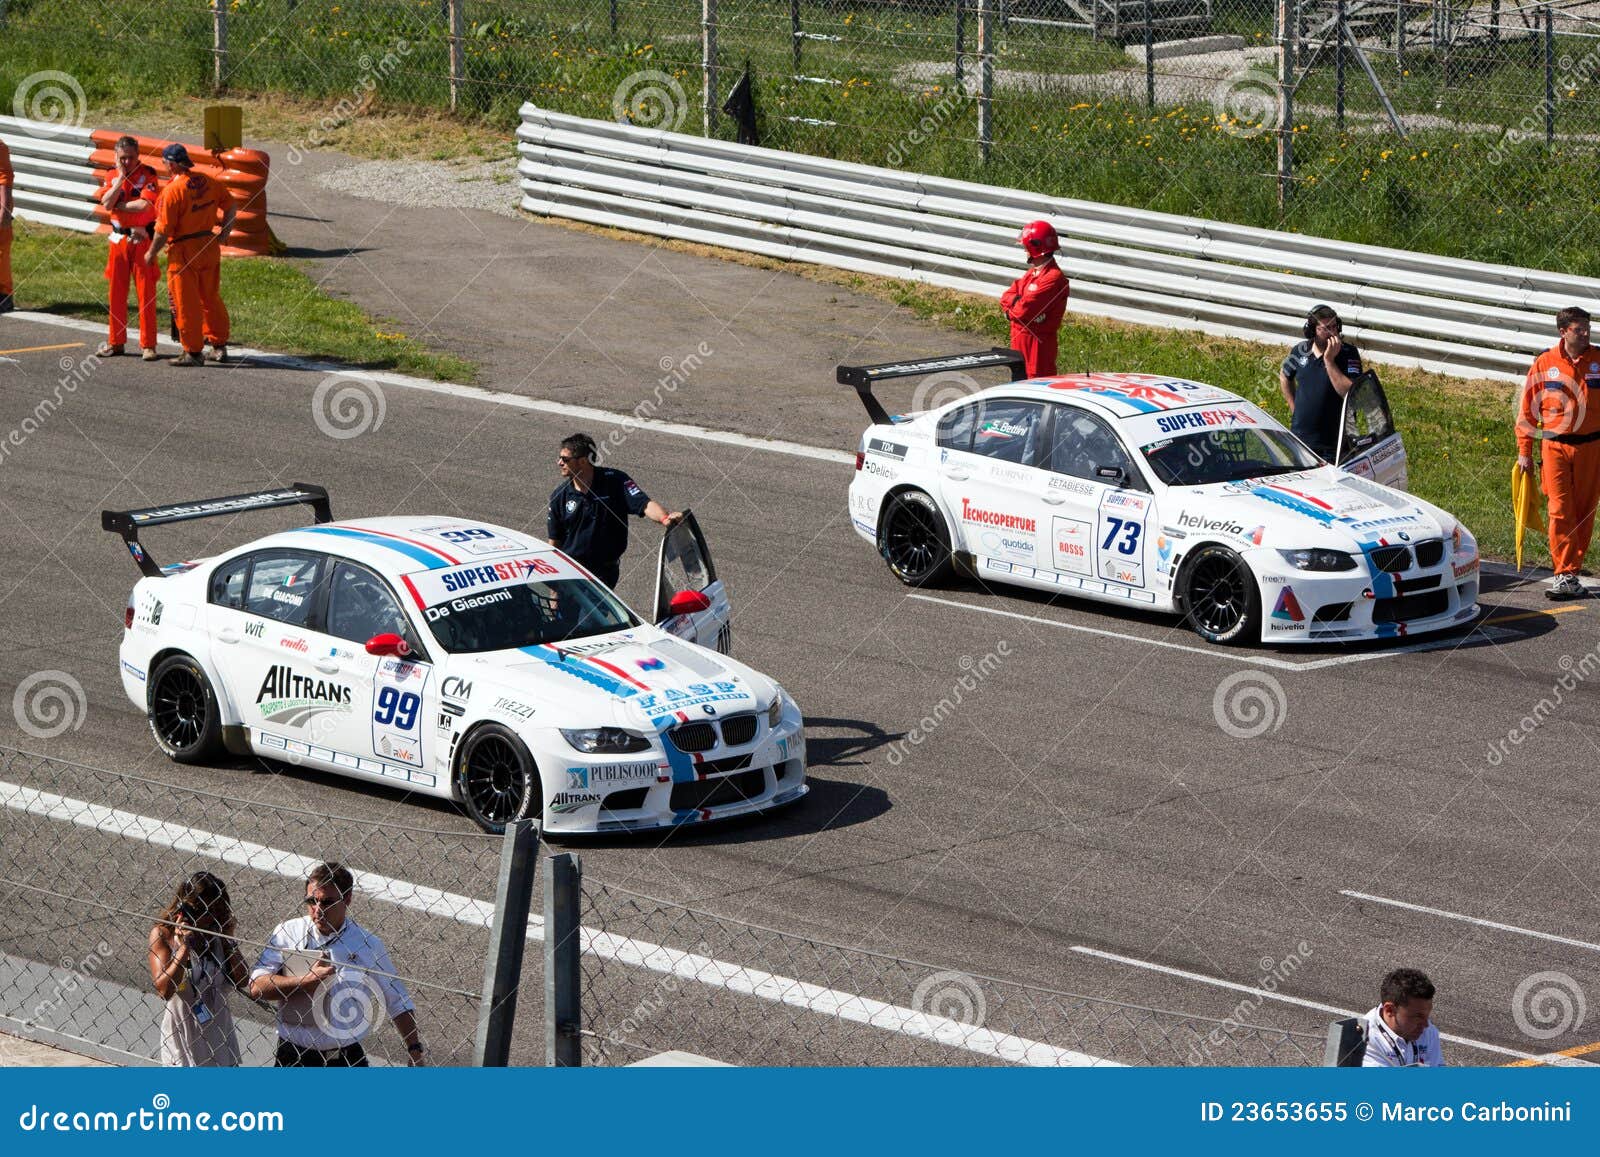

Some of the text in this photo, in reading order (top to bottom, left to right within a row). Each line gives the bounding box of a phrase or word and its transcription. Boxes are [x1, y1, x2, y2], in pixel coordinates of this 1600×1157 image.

[1154, 382, 1200, 392] 73
[1000, 422, 1028, 436] Bettini
[1157, 409, 1257, 433] SUPERSTARS
[881, 442, 894, 452] TDA
[1177, 509, 1244, 534] helvetia
[440, 529, 495, 543] 99
[1102, 517, 1142, 555] 73
[441, 559, 560, 592] SUPERSTARS
[273, 589, 304, 606] GIACOMI
[424, 588, 513, 621] De Giacomi
[245, 621, 265, 638] wit
[1271, 623, 1305, 631] helvetia
[441, 676, 472, 699] CM
[375, 686, 421, 731] 99
[591, 763, 657, 781] PUBLISCOOP
